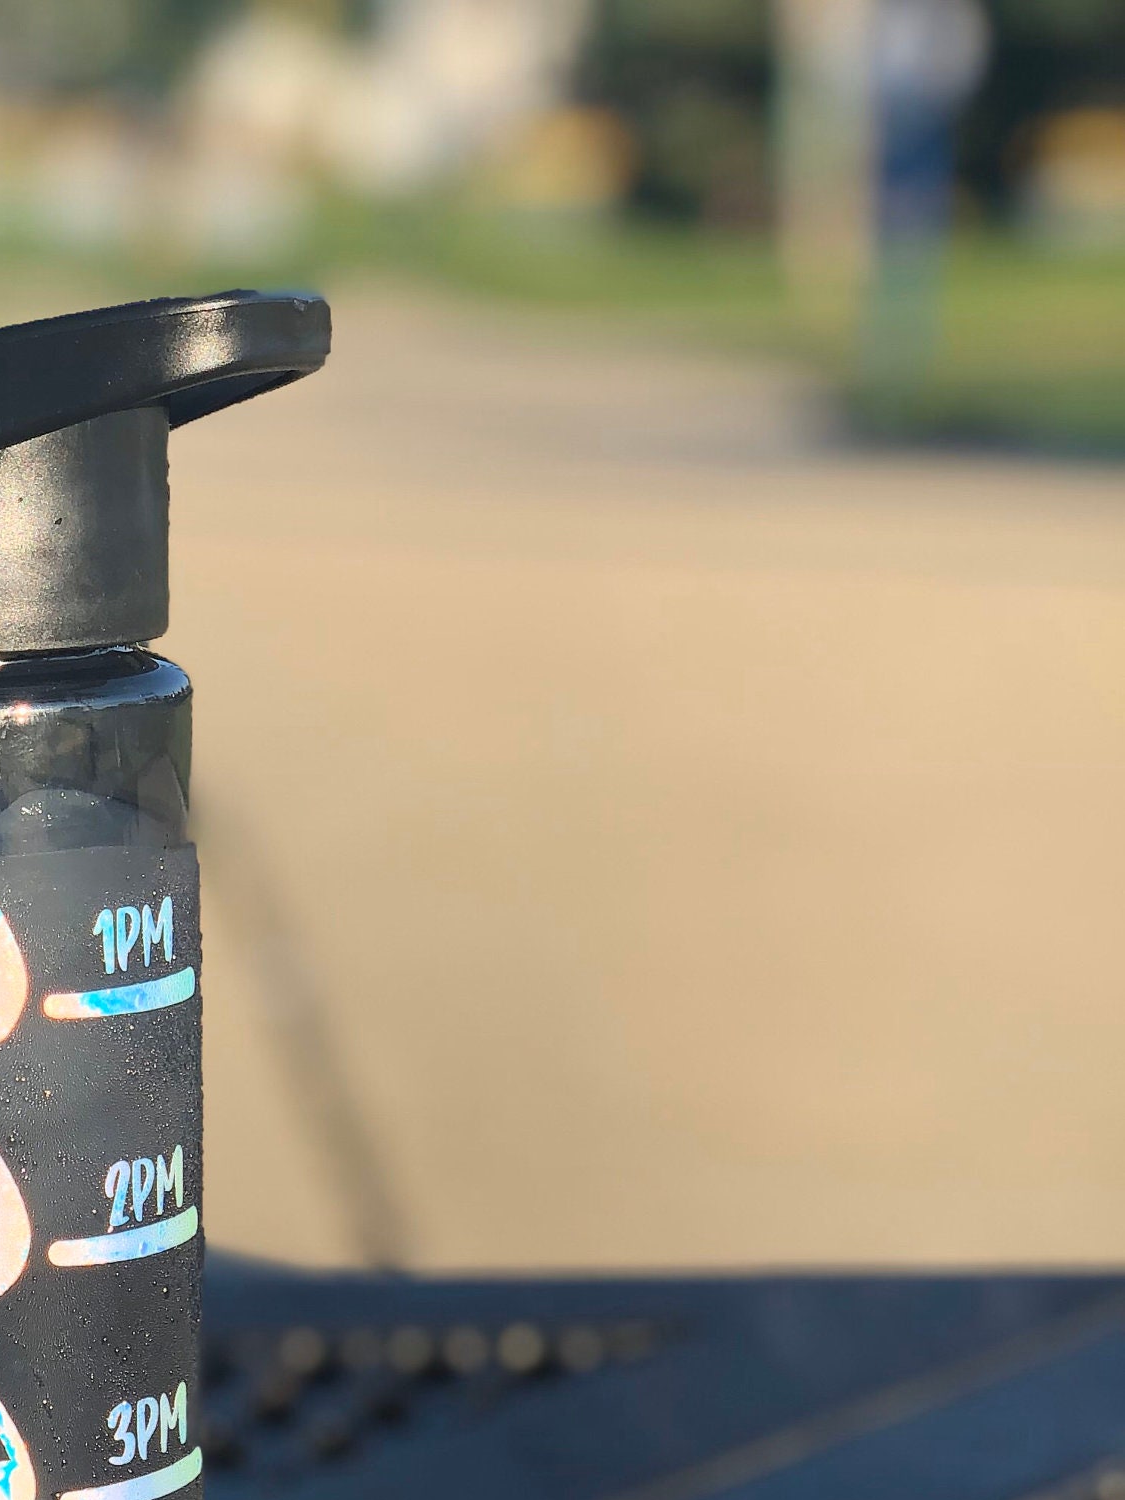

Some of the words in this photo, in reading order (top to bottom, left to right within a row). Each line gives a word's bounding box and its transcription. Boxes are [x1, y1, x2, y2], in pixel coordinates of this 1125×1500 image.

[93, 896, 174, 975] 1PM
[105, 1144, 184, 1227] 2PM
[108, 1382, 187, 1466] 3PM
